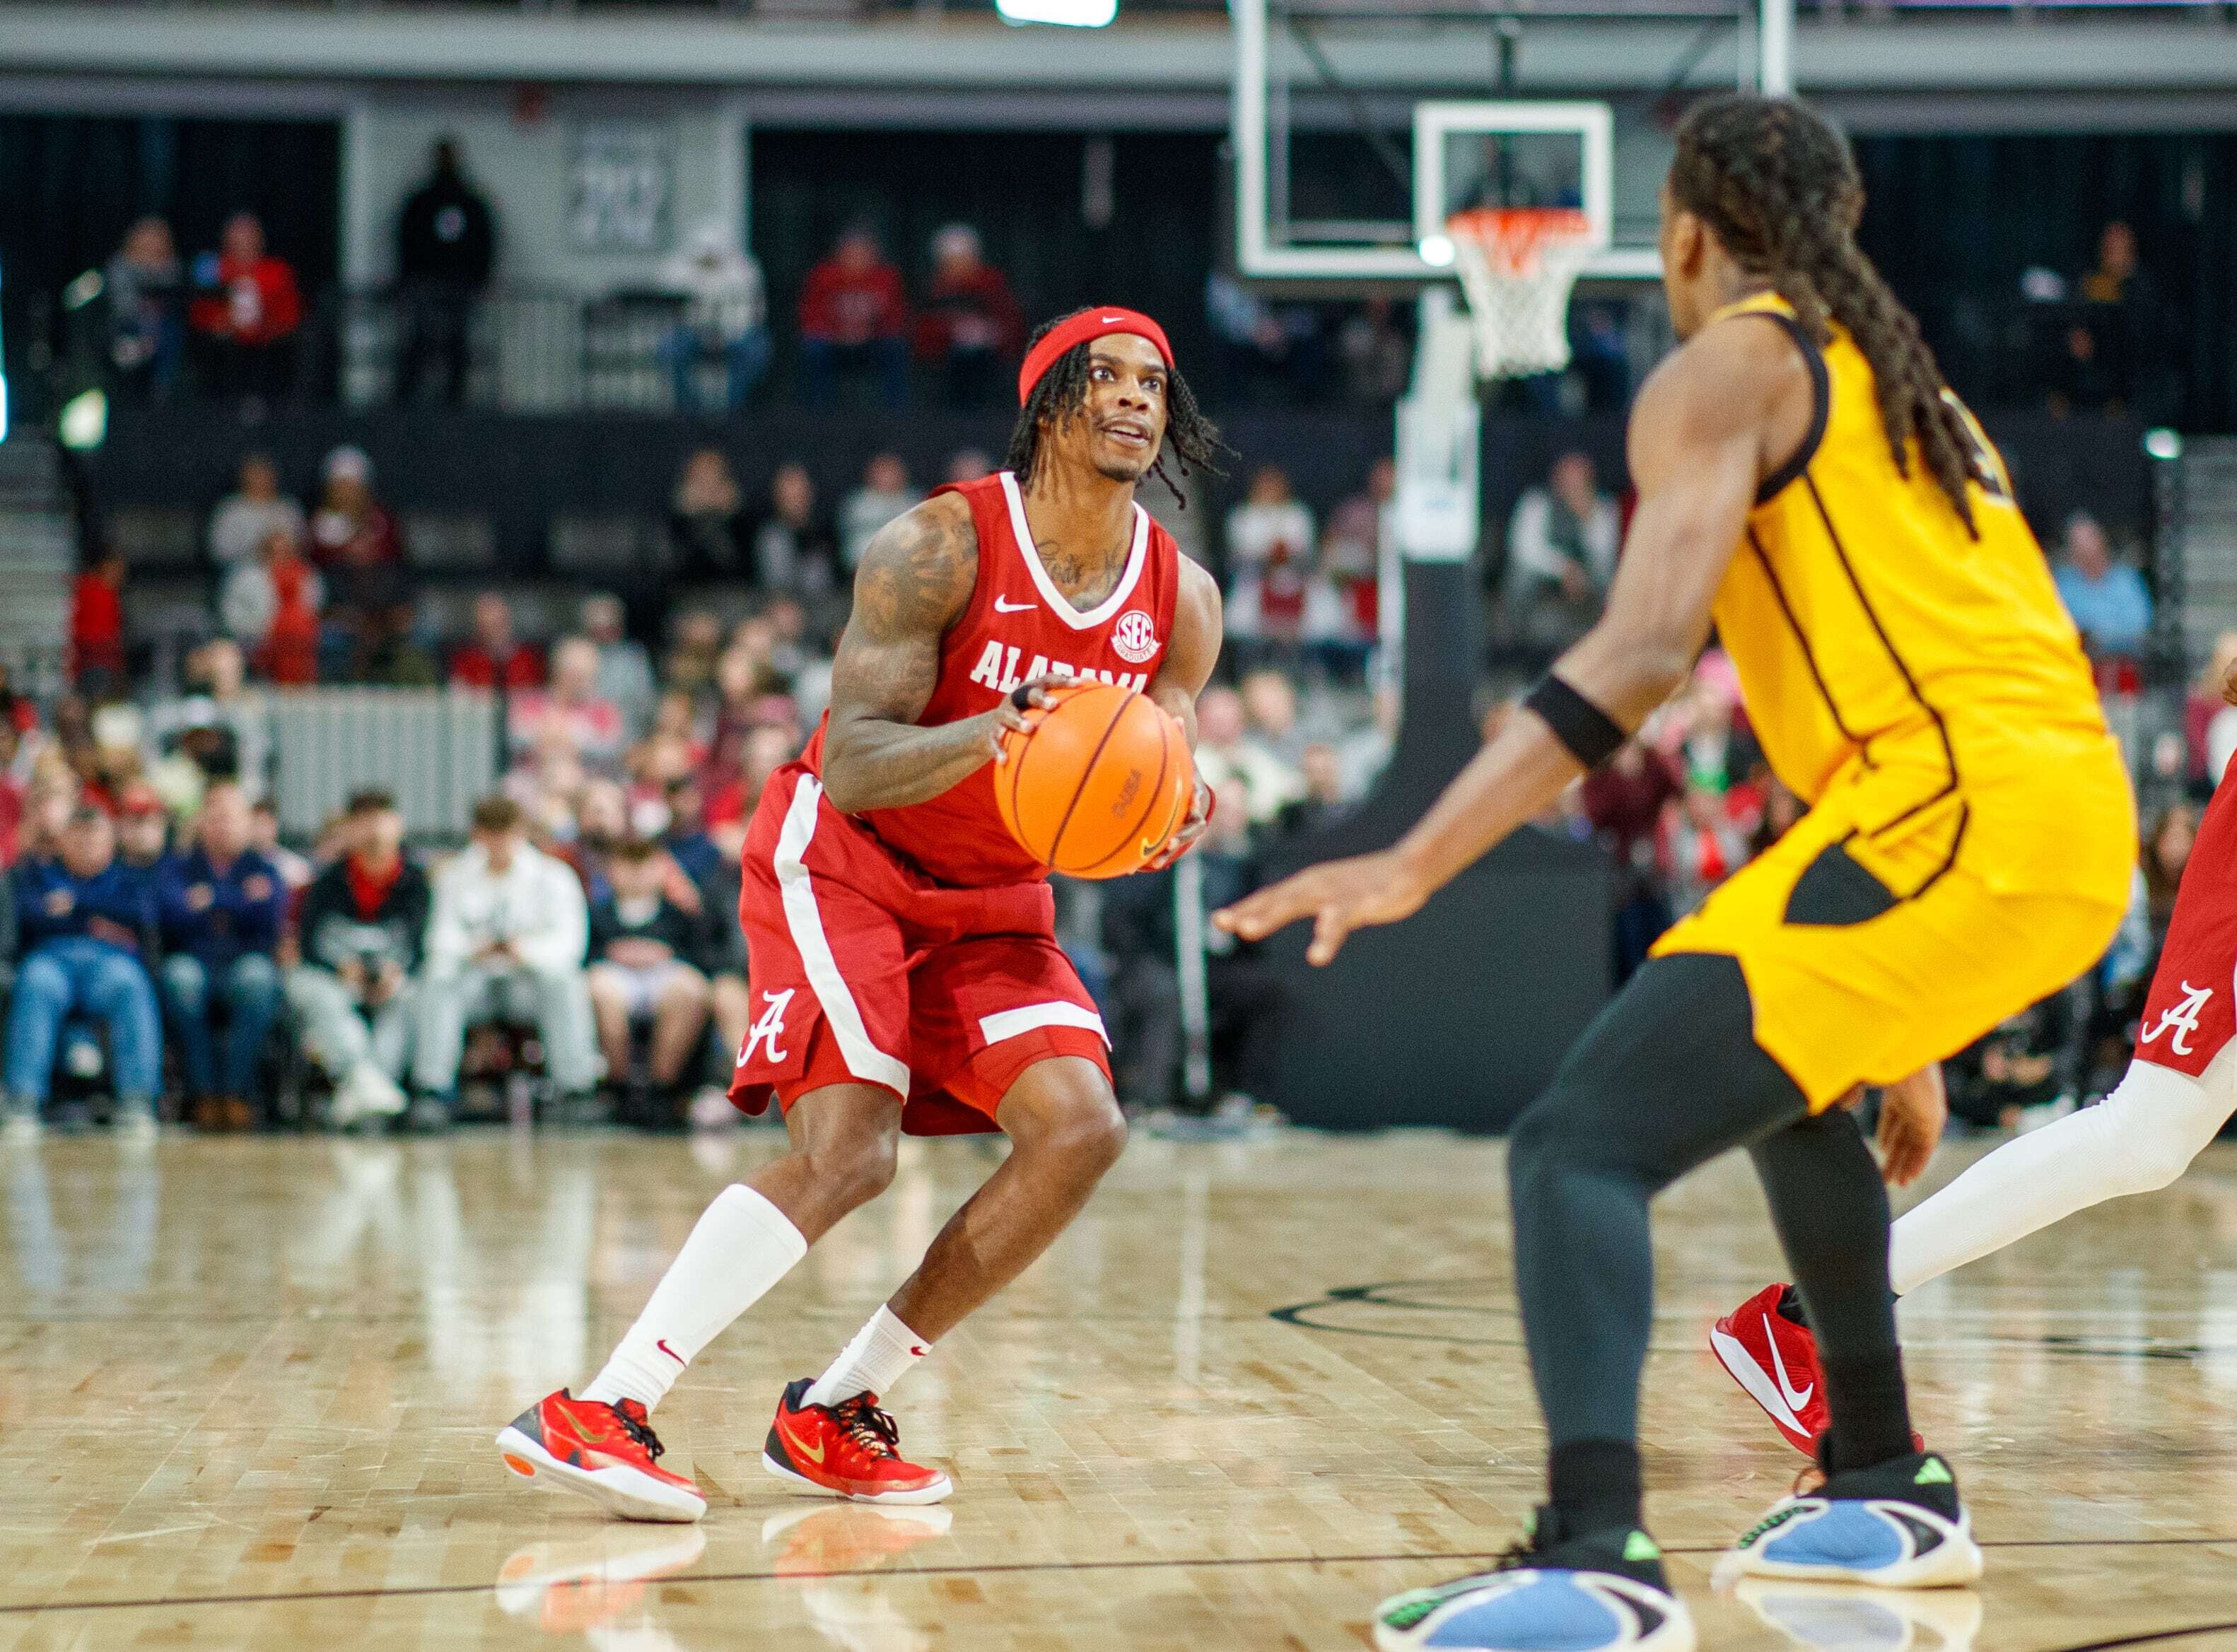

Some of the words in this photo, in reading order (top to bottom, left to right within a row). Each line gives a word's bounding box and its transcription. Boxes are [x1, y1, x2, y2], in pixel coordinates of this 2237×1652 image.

[1119, 613, 1151, 650] SEC
[970, 640, 1147, 694] ALAA
[737, 988, 795, 1067] A
[2142, 980, 2214, 1055] A
